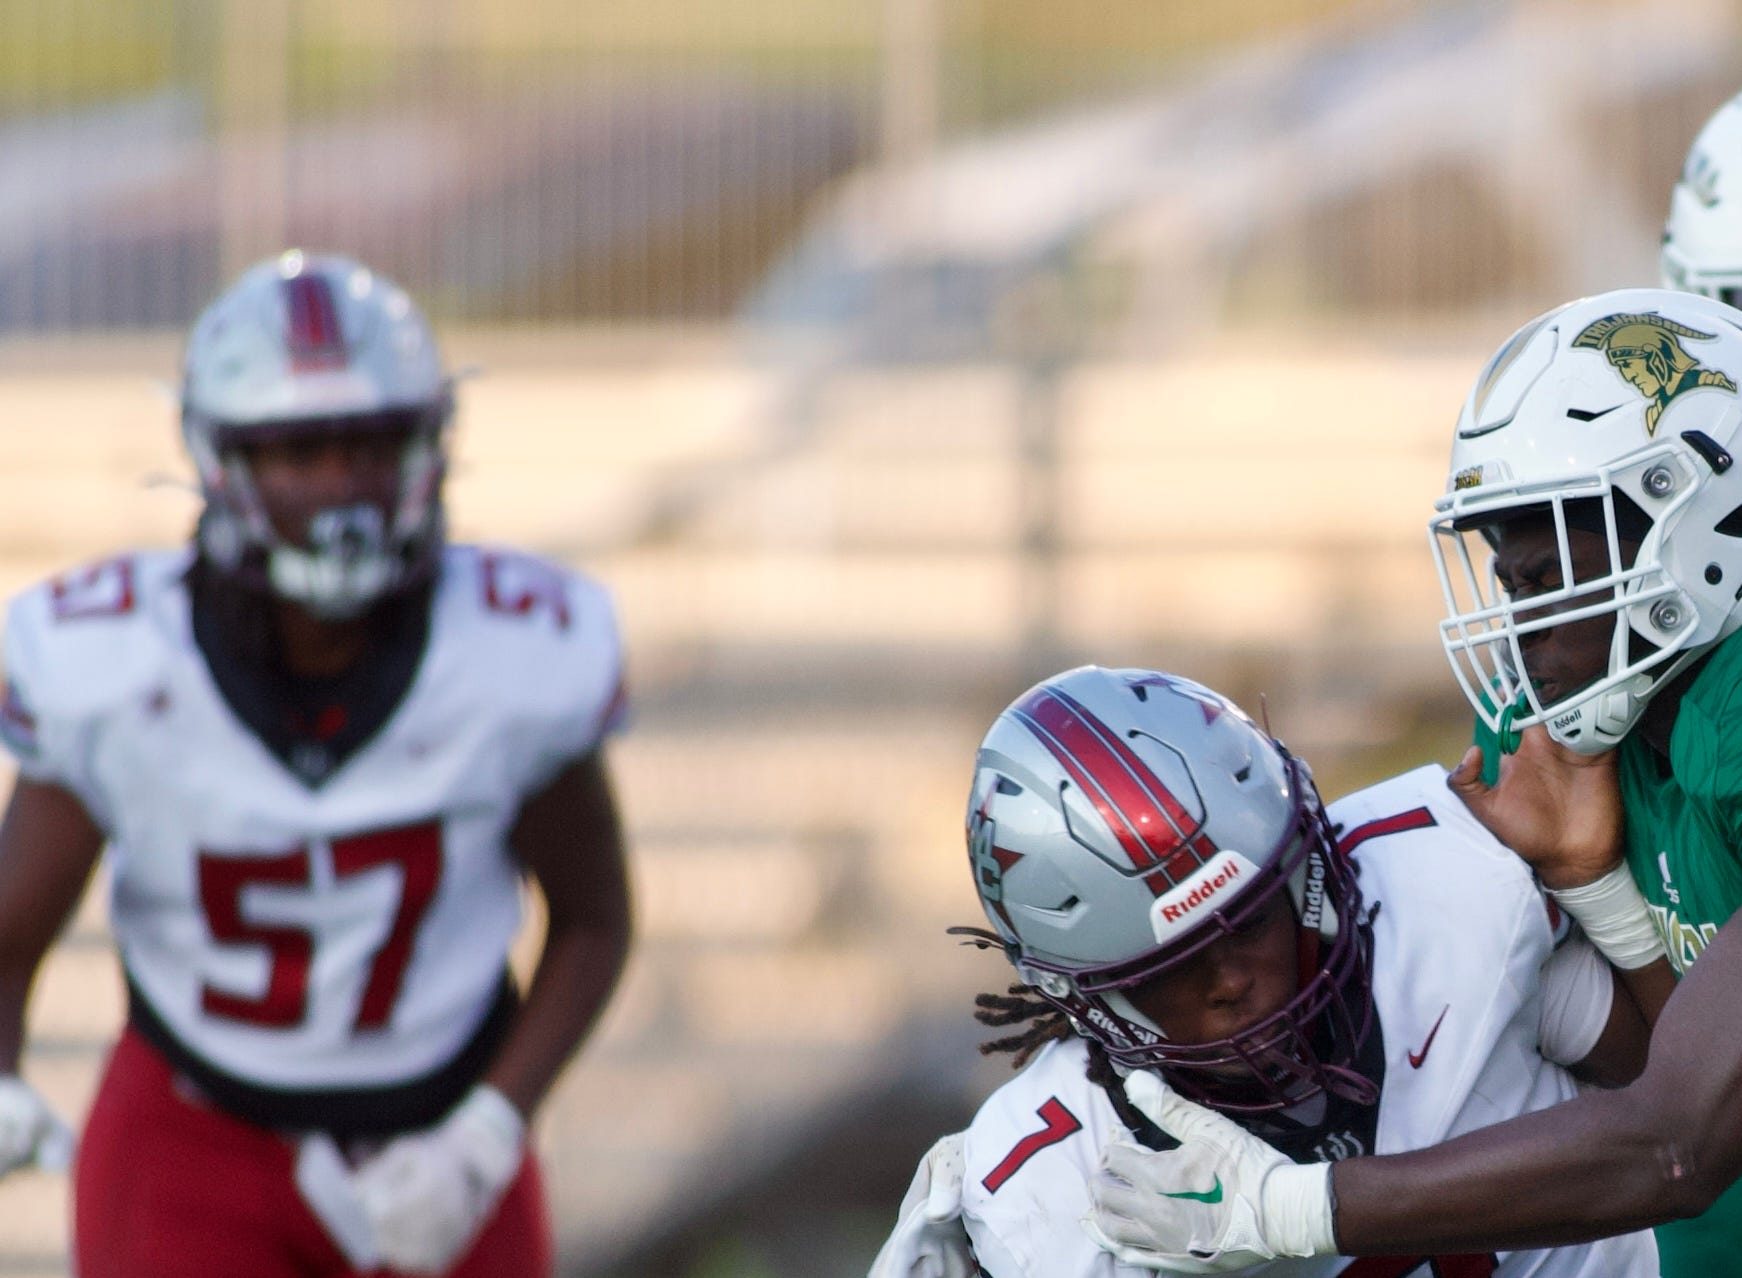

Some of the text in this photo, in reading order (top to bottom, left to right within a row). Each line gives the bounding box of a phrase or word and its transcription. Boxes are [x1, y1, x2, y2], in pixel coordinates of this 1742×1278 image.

[198, 819, 445, 1033] 57
[1161, 859, 1241, 924] Riddell
[1302, 852, 1326, 929] Riddell
[982, 1095, 1083, 1195] 7
